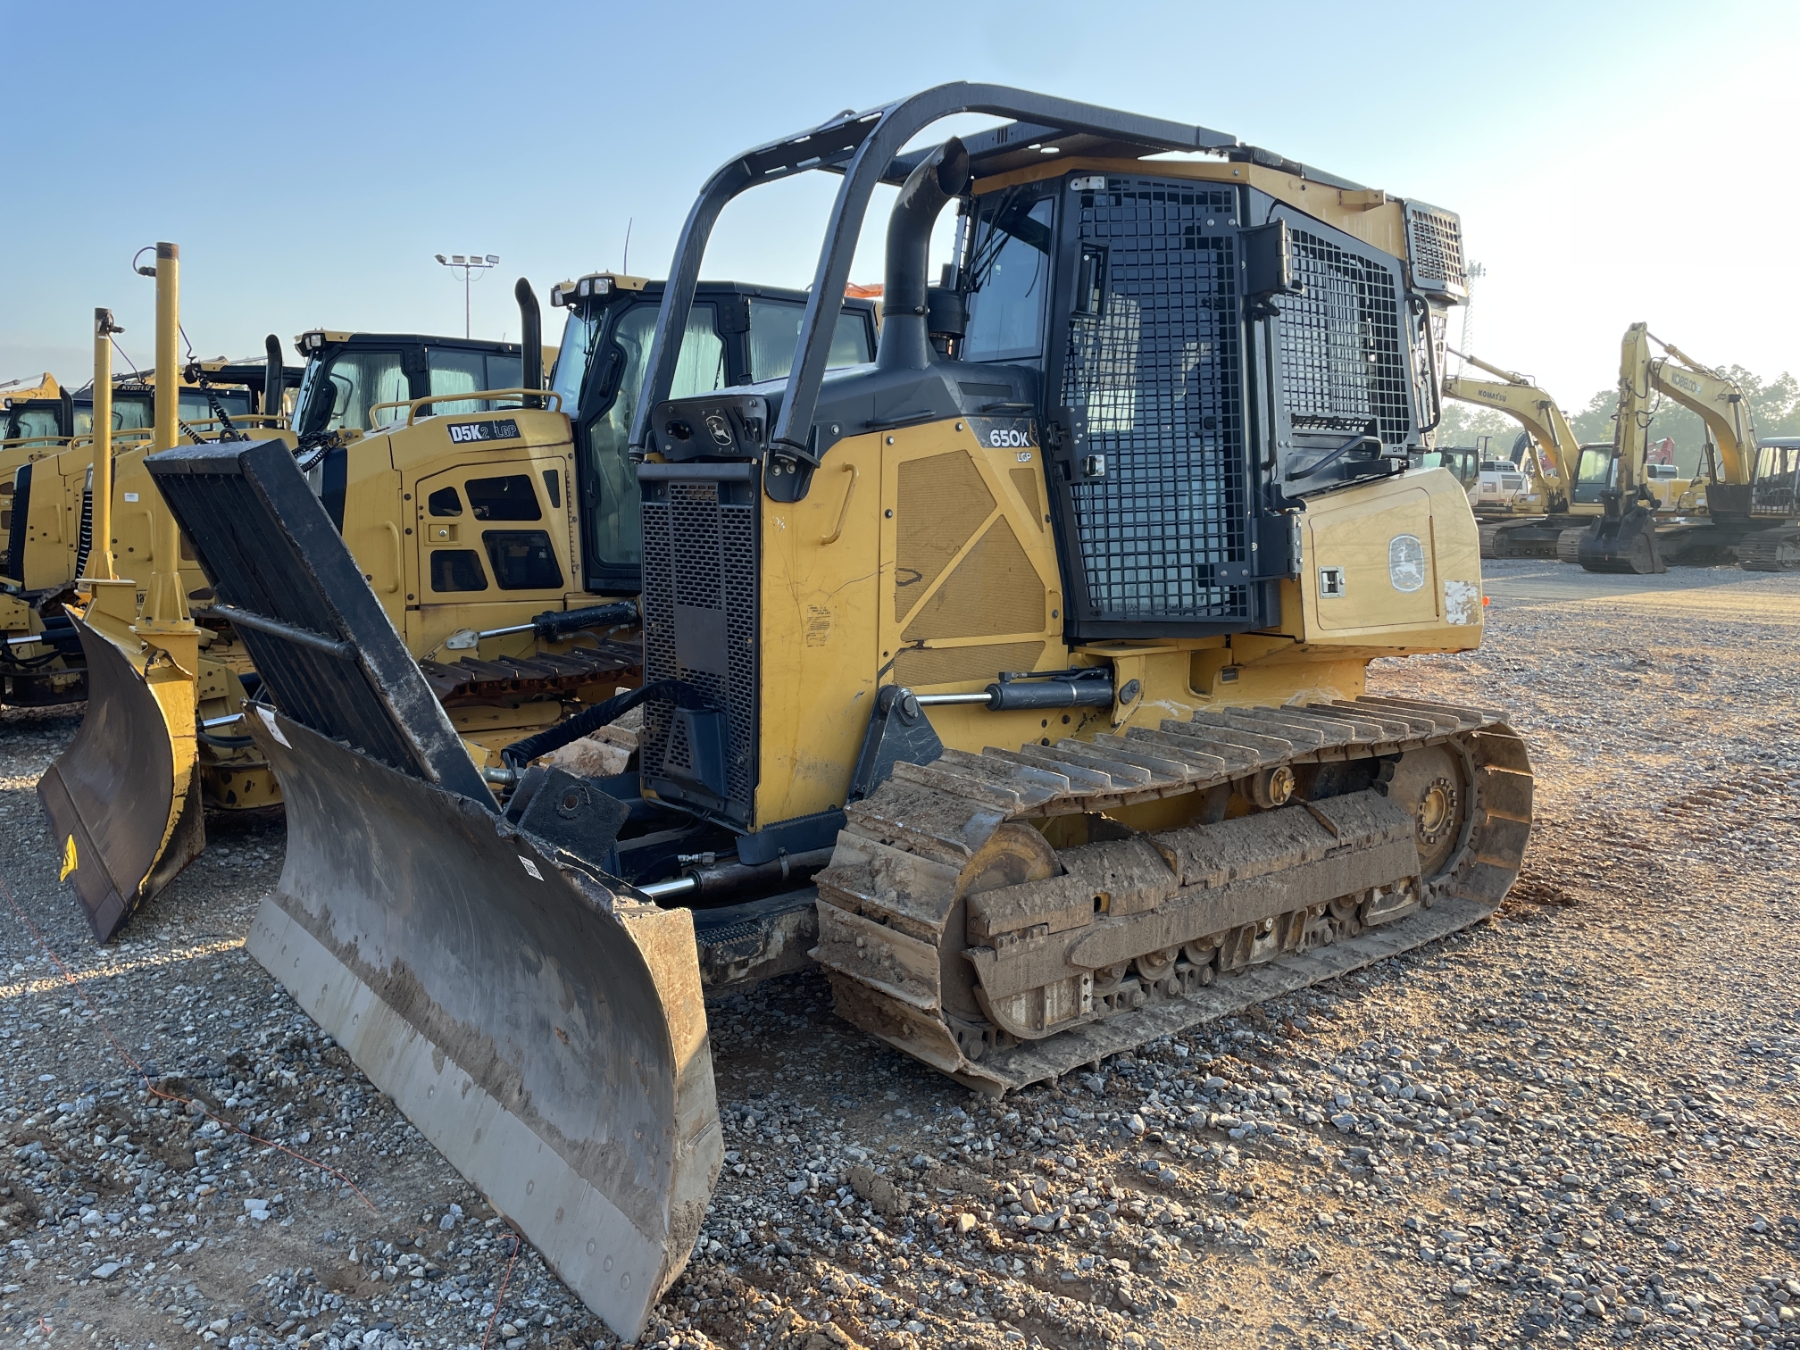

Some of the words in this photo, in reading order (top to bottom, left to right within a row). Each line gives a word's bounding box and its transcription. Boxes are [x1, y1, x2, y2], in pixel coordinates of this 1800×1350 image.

[1671, 371, 1697, 393] KOBELCO
[1477, 389, 1507, 402] KOMATSU
[451, 424, 489, 442] D5K2
[494, 424, 517, 438] LGP
[989, 429, 1030, 447] 650K
[1016, 452, 1032, 463] LGP
